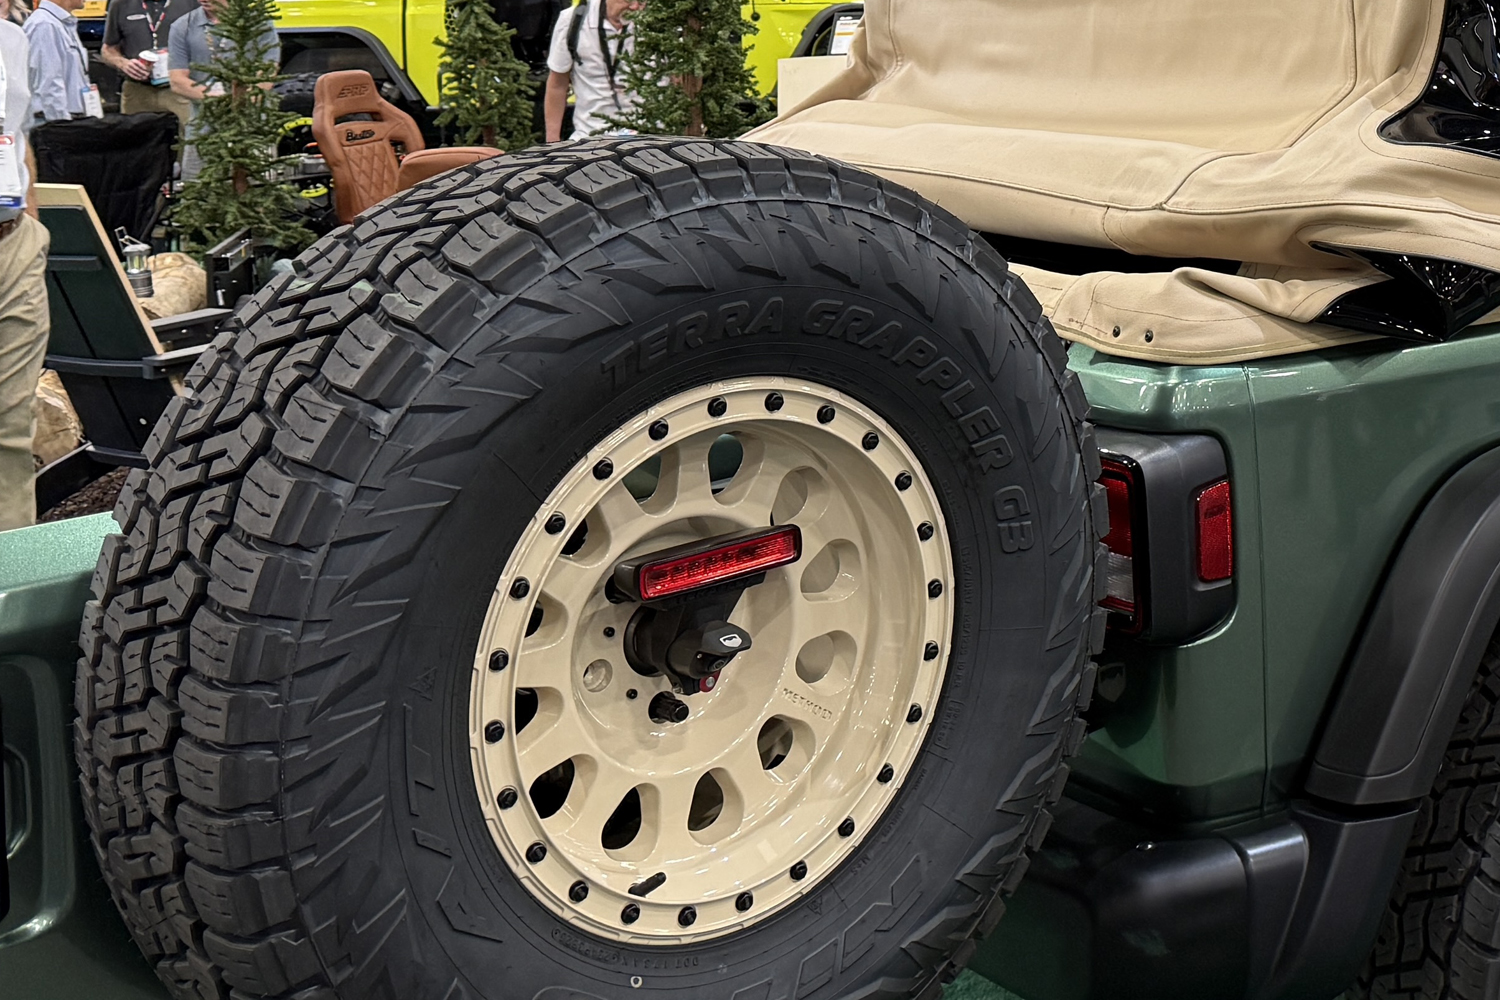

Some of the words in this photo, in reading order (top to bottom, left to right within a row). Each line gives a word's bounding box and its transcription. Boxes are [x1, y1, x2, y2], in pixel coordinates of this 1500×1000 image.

[601, 297, 784, 388] TERRA
[802, 299, 1014, 475] GRAPPLER
[783, 687, 833, 720] METHOD
